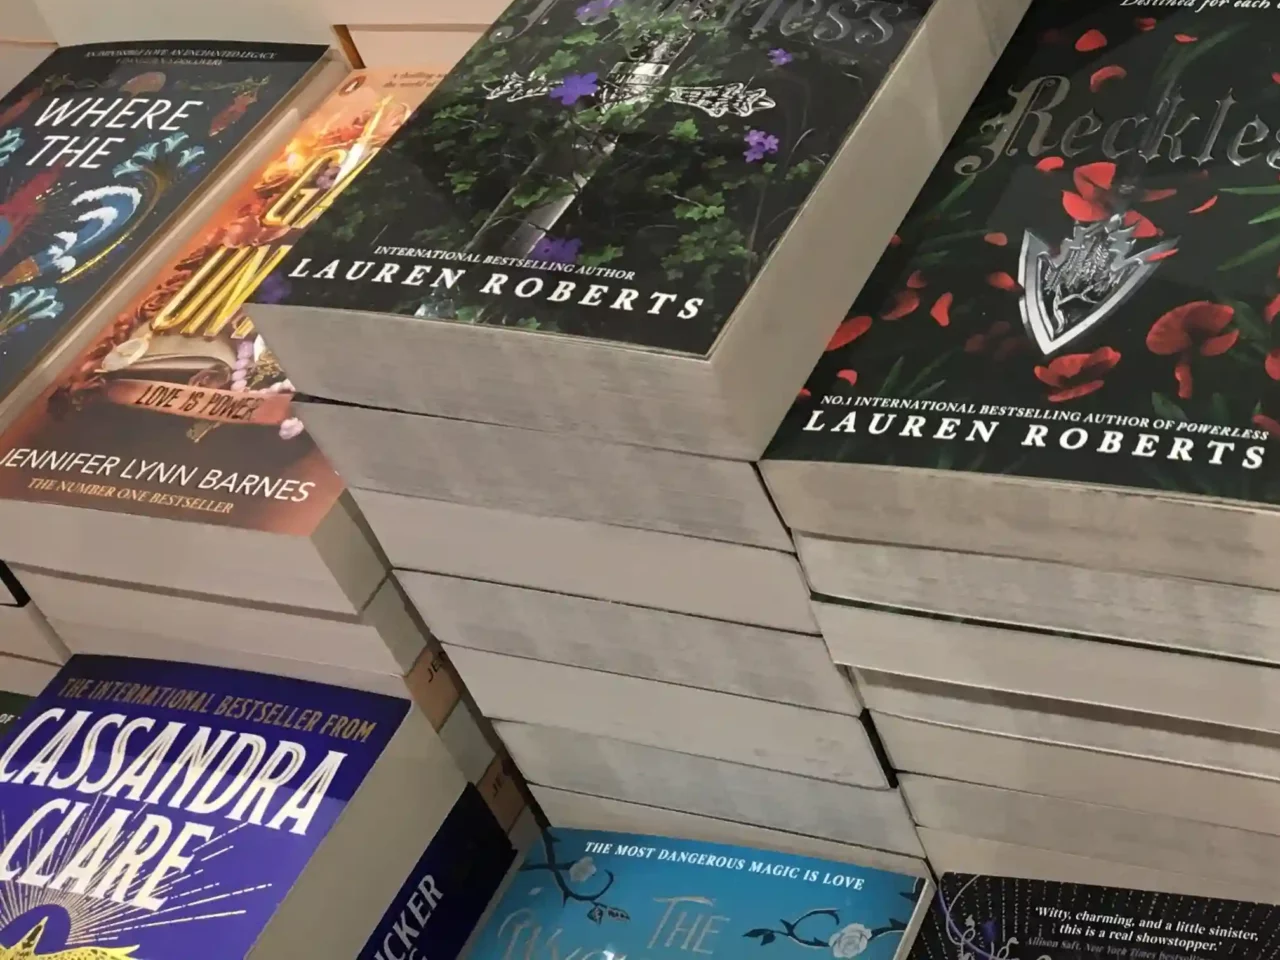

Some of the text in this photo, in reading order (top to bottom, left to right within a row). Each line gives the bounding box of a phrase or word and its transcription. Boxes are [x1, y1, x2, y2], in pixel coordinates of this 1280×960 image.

[34, 95, 204, 134] WHERE
[24, 134, 126, 171] THE
[288, 255, 705, 321] LAUREN ROBERTS
[373, 246, 636, 281] INTERNATIONAL BESTSELLING AUTHOR
[135, 382, 265, 422] LOVE IS POWER
[820, 393, 1271, 441] NO.1 INTERNATIONAL BESTSELLING AUTHOR OF POWERLESS
[802, 406, 1268, 471] LAUREN ROBERTS
[0, 448, 316, 505] JENNIFER LYNN BARNES
[28, 478, 234, 515] THE NUMBER ONE BESTSELLER
[58, 676, 377, 745] THE INTERNATIONAL BESTSELLER FROM
[0, 707, 348, 837] CASSANDRA
[0, 797, 214, 913] CLARE
[584, 841, 865, 892] THE MOST DANGEROUS MAGIC IS LOVE
[646, 889, 733, 959] THE
[1058, 921, 1133, 941] this is a real
[1074, 909, 1260, 942] charming, and a little sinister,
